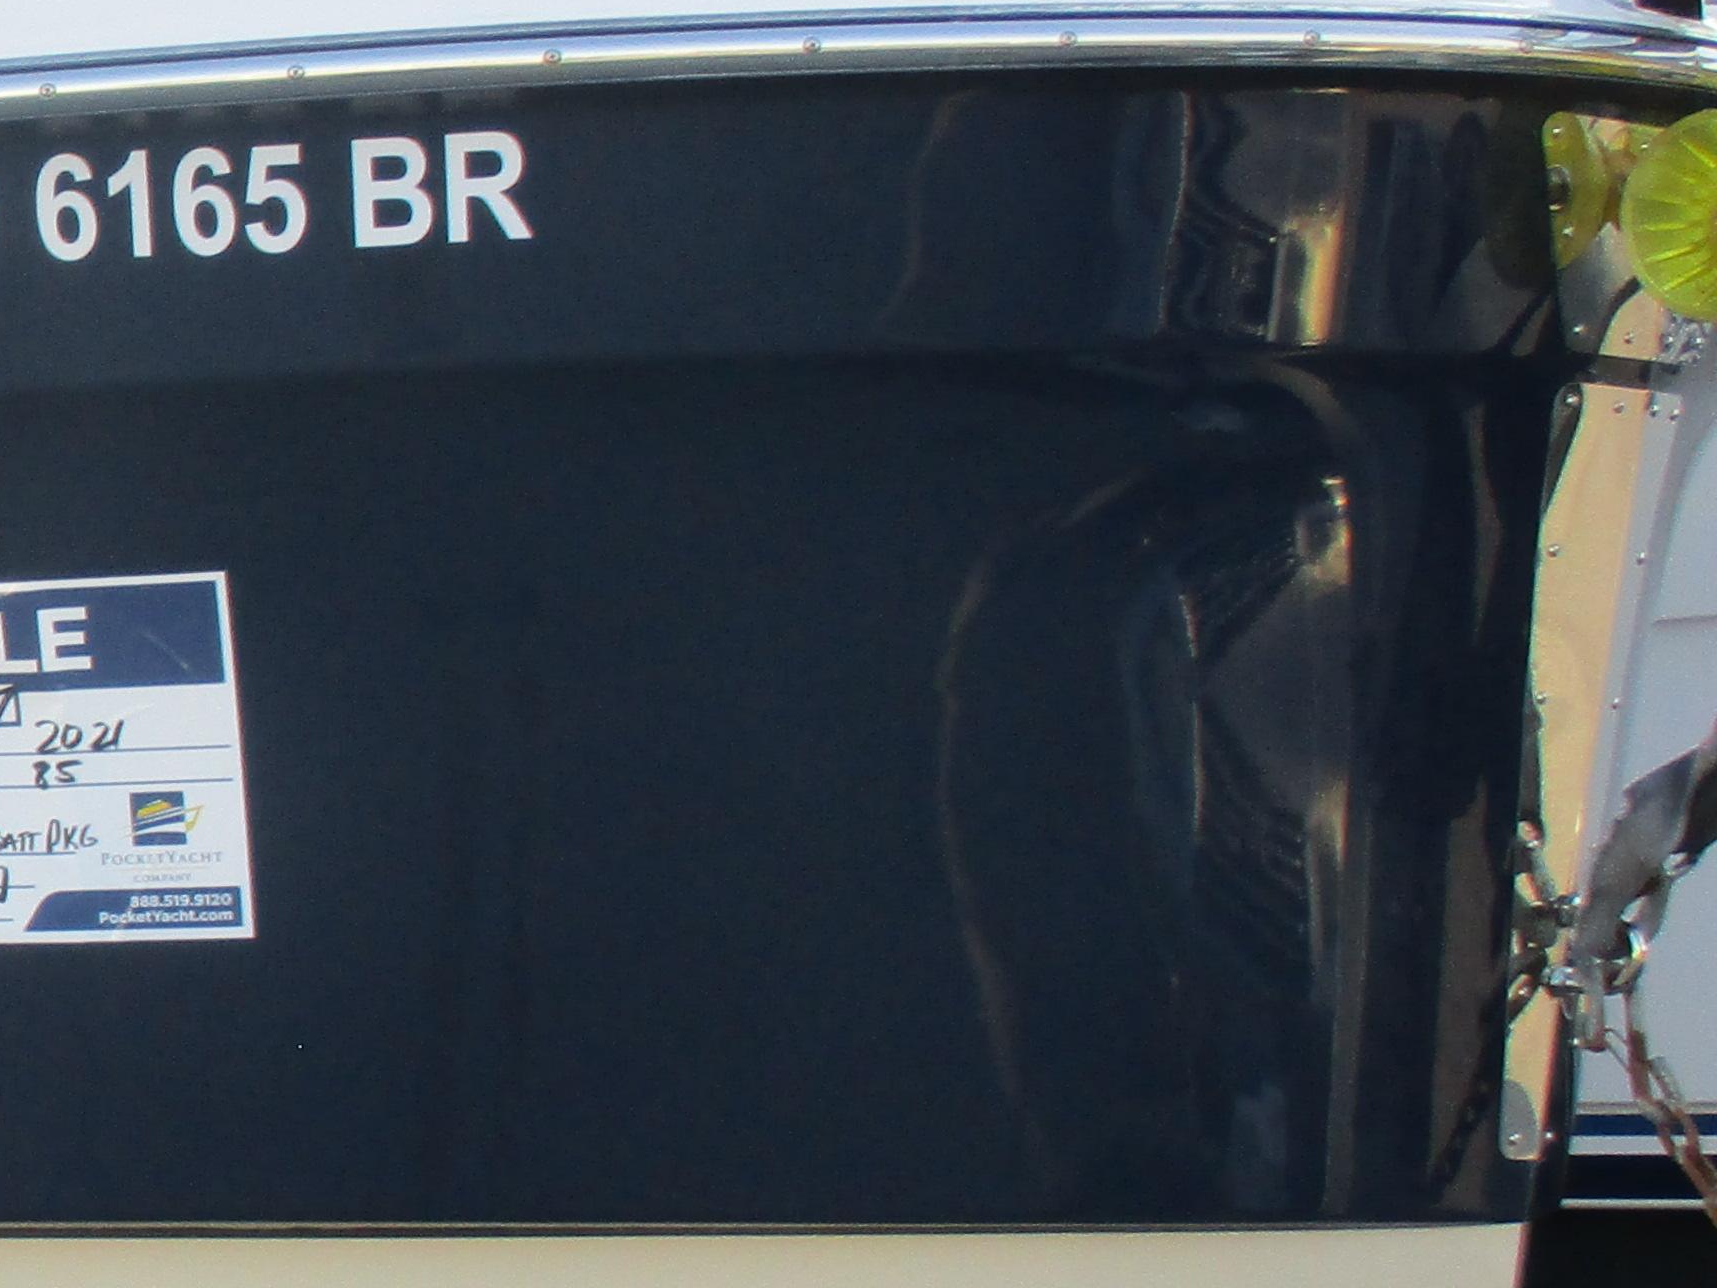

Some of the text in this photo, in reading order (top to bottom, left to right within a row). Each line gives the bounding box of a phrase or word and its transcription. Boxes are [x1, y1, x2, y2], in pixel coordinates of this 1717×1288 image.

[34, 144, 307, 262] 6165
[350, 130, 533, 249] BR
[34, 718, 125, 754] 2021
[32, 759, 83, 790] 85
[129, 892, 233, 909] 888.519.9120
[98, 909, 235, 924] PocketYacht.com
